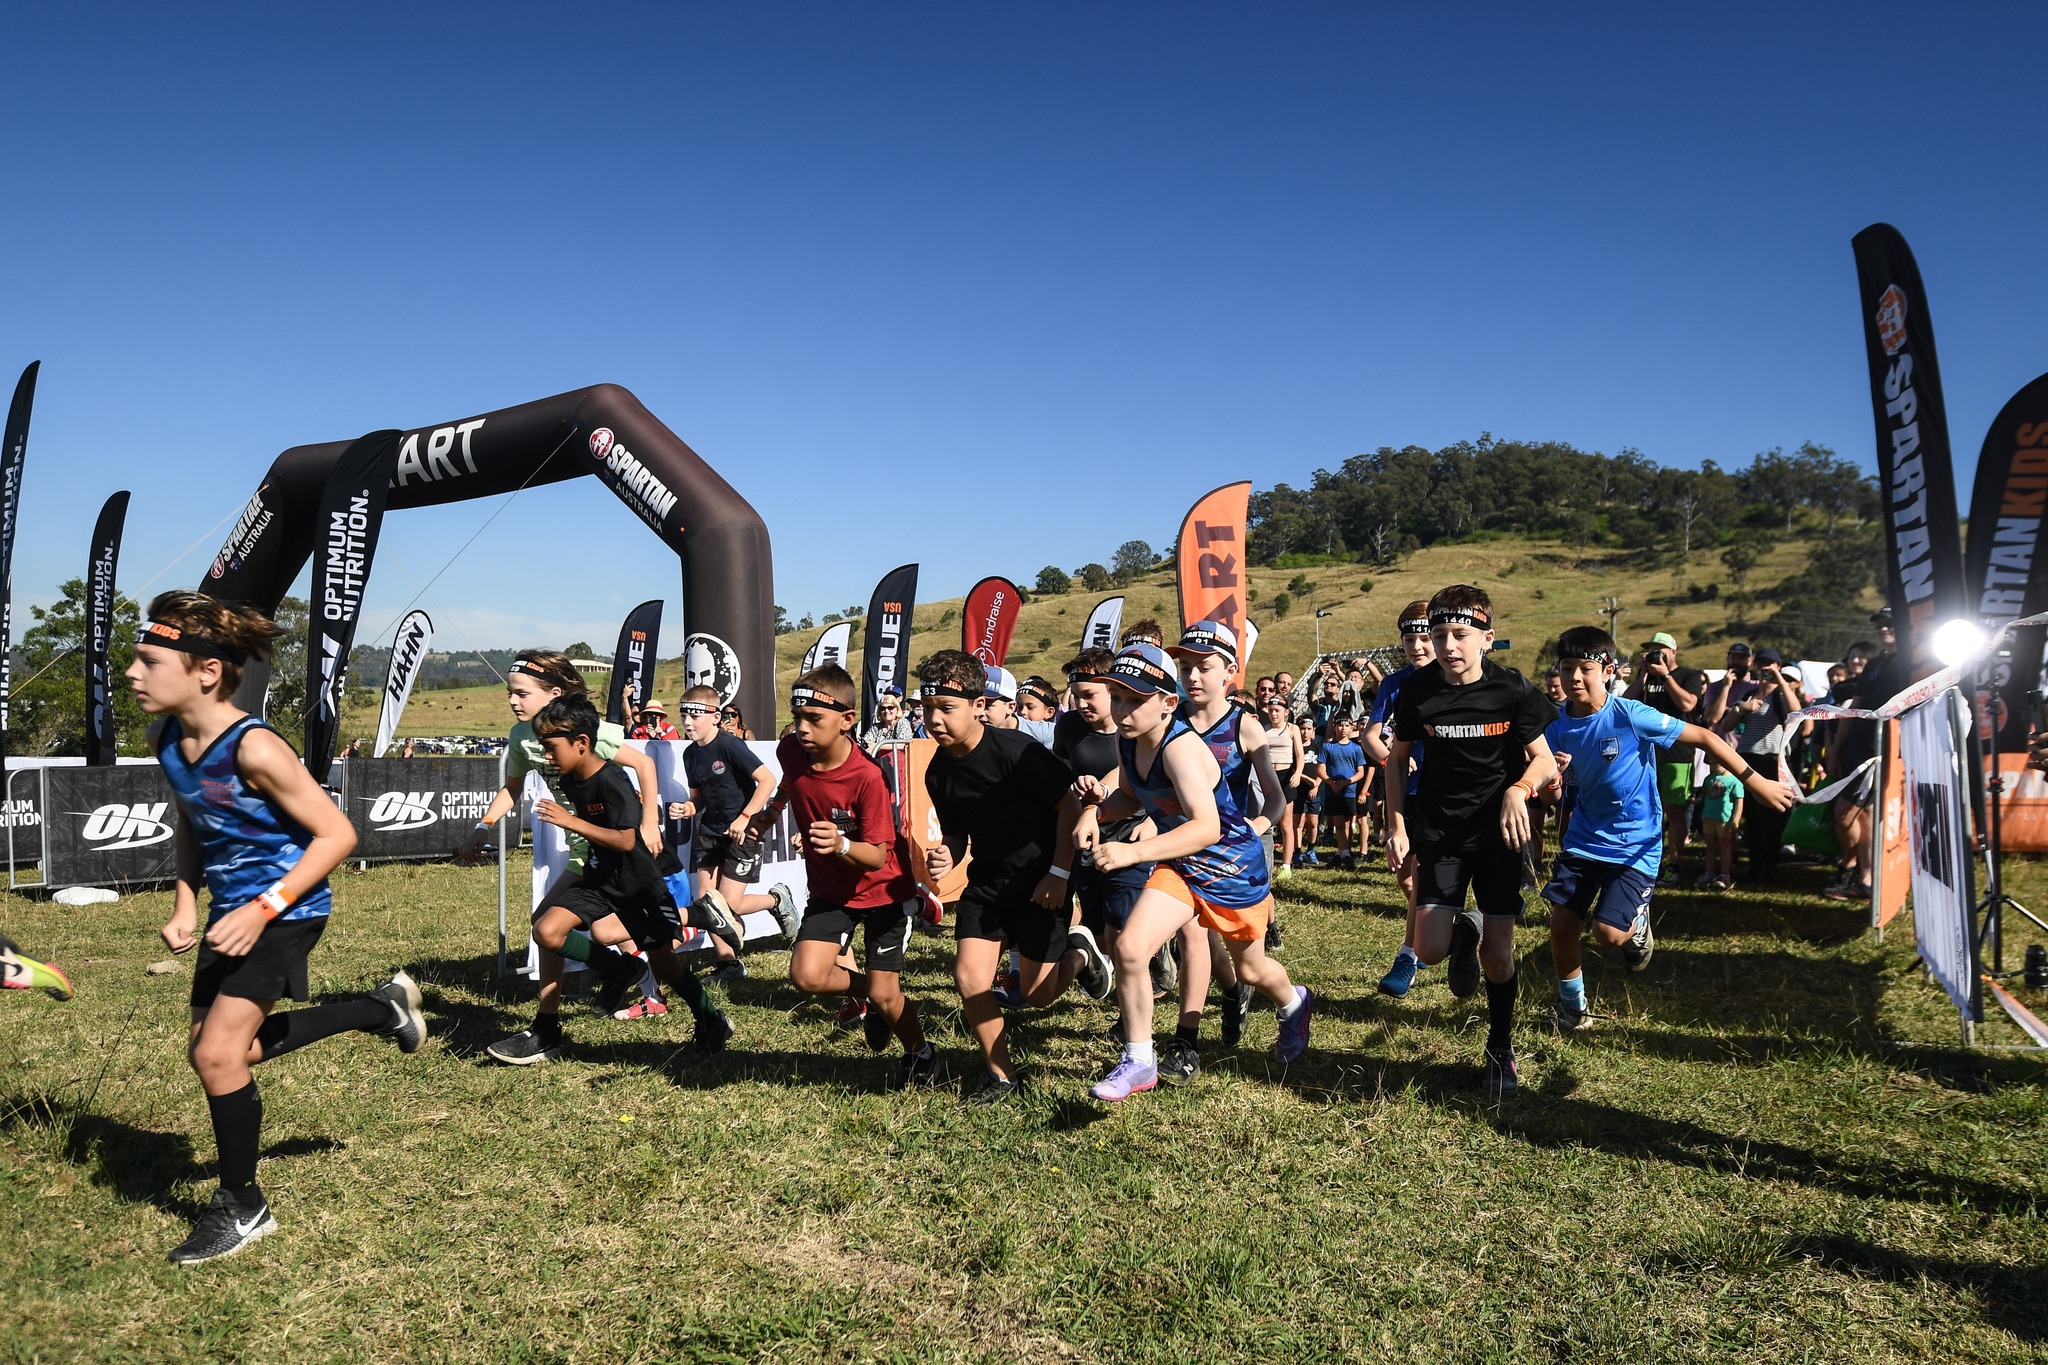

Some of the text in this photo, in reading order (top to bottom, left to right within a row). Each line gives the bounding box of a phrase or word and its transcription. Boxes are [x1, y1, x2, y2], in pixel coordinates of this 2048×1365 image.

[390, 418, 487, 488] ART
[606, 443, 678, 520] SPARTAN
[222, 490, 264, 561] SPARTAN
[616, 481, 663, 533] AUSTRALIA
[238, 510, 274, 561] AUSTRALIA
[323, 511, 349, 621] OPTIMUM
[883, 601, 902, 613] USA
[1444, 616, 1472, 627] 1440
[631, 630, 647, 642] USA
[388, 621, 424, 703] HAHN
[1115, 665, 1142, 678] 1202
[795, 698, 808, 706] 82
[924, 687, 936, 696] 83
[83, 802, 173, 847] ON
[369, 791, 437, 829] ON
